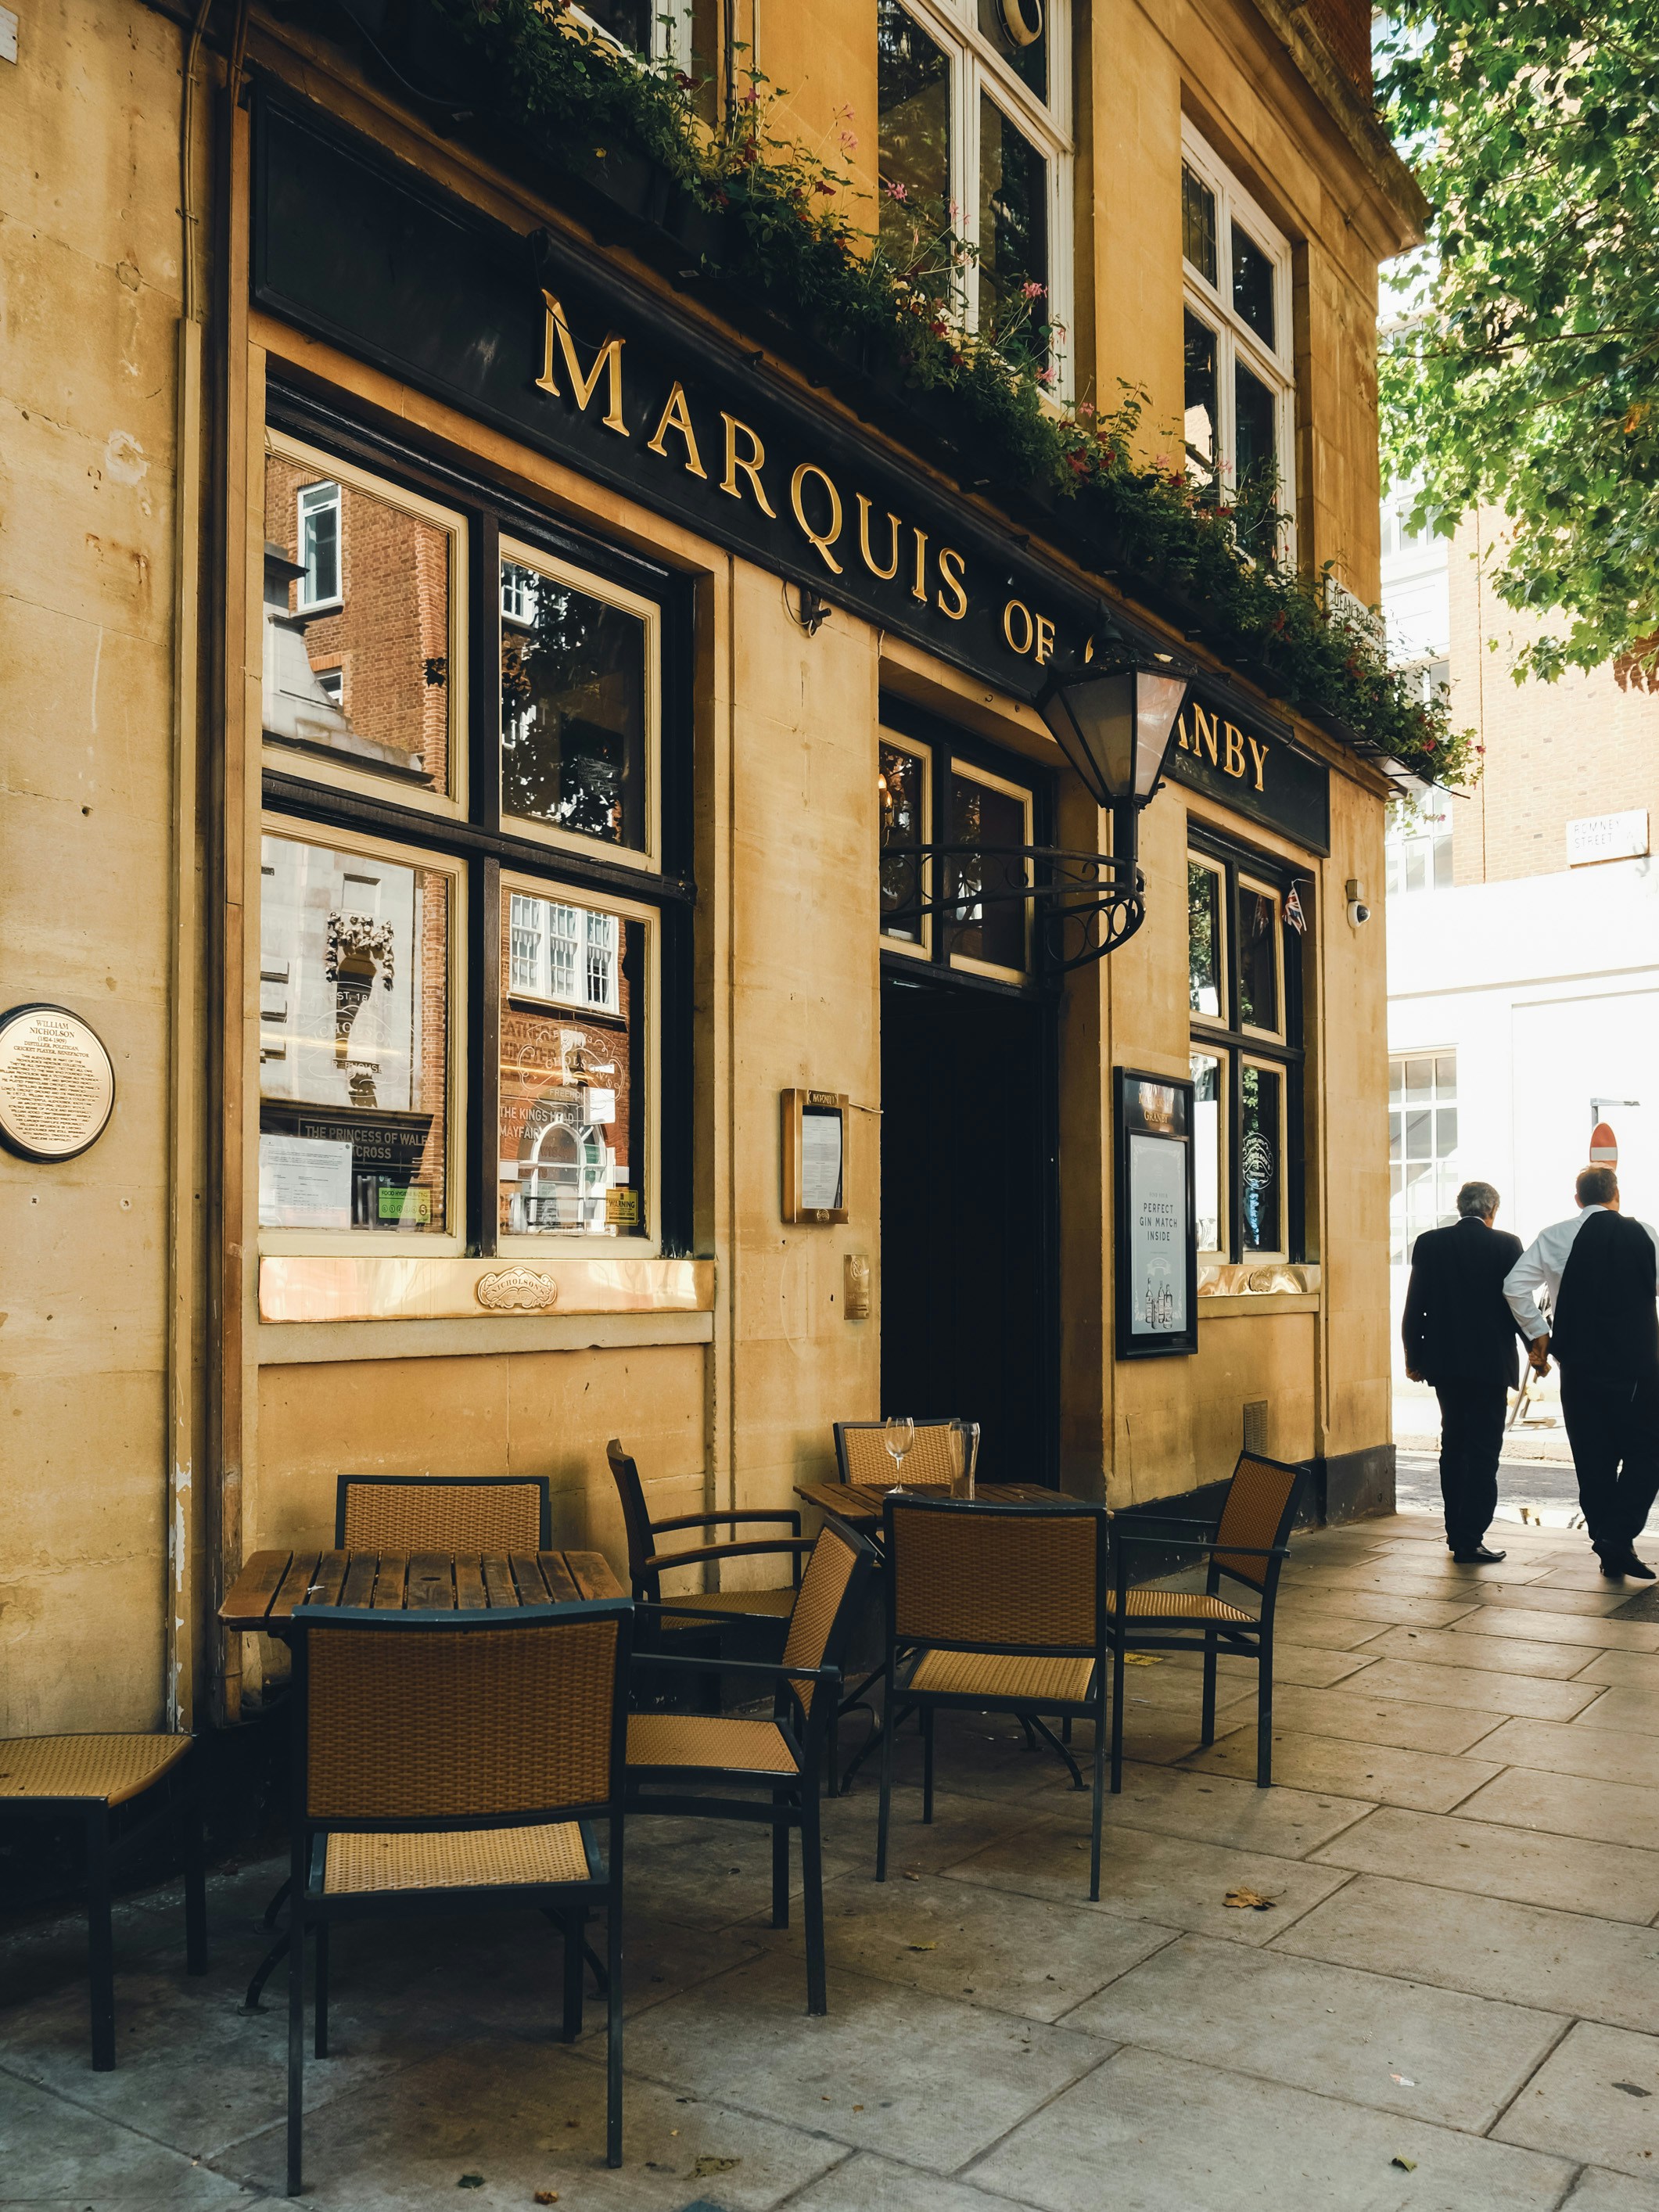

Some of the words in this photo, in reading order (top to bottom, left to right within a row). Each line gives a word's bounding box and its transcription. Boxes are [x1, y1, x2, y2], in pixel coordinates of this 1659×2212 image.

[536, 289, 968, 620] MARQUIS
[1004, 599, 1056, 666] OF
[1574, 832, 1613, 849] STREET
[36, 1019, 69, 1030] WILLIAM
[29, 1027, 75, 1039] NICHOLSON
[813, 1093, 835, 1105] MENU
[500, 1105, 518, 1119] THE
[519, 1108, 548, 1122] KINGS
[305, 1125, 326, 1139] THE
[329, 1127, 382, 1144] PRINCESS
[384, 1132, 397, 1144] OF
[500, 1124, 540, 1140] MAYFAIR
[356, 1145, 392, 1159] CROSS
[609, 1199, 635, 1208] WARNING
[1143, 1202, 1173, 1214] PERFECT
[1139, 1216, 1151, 1226] GIN
[1155, 1217, 1177, 1228] MATCH
[1147, 1230, 1170, 1241] INSIDE
